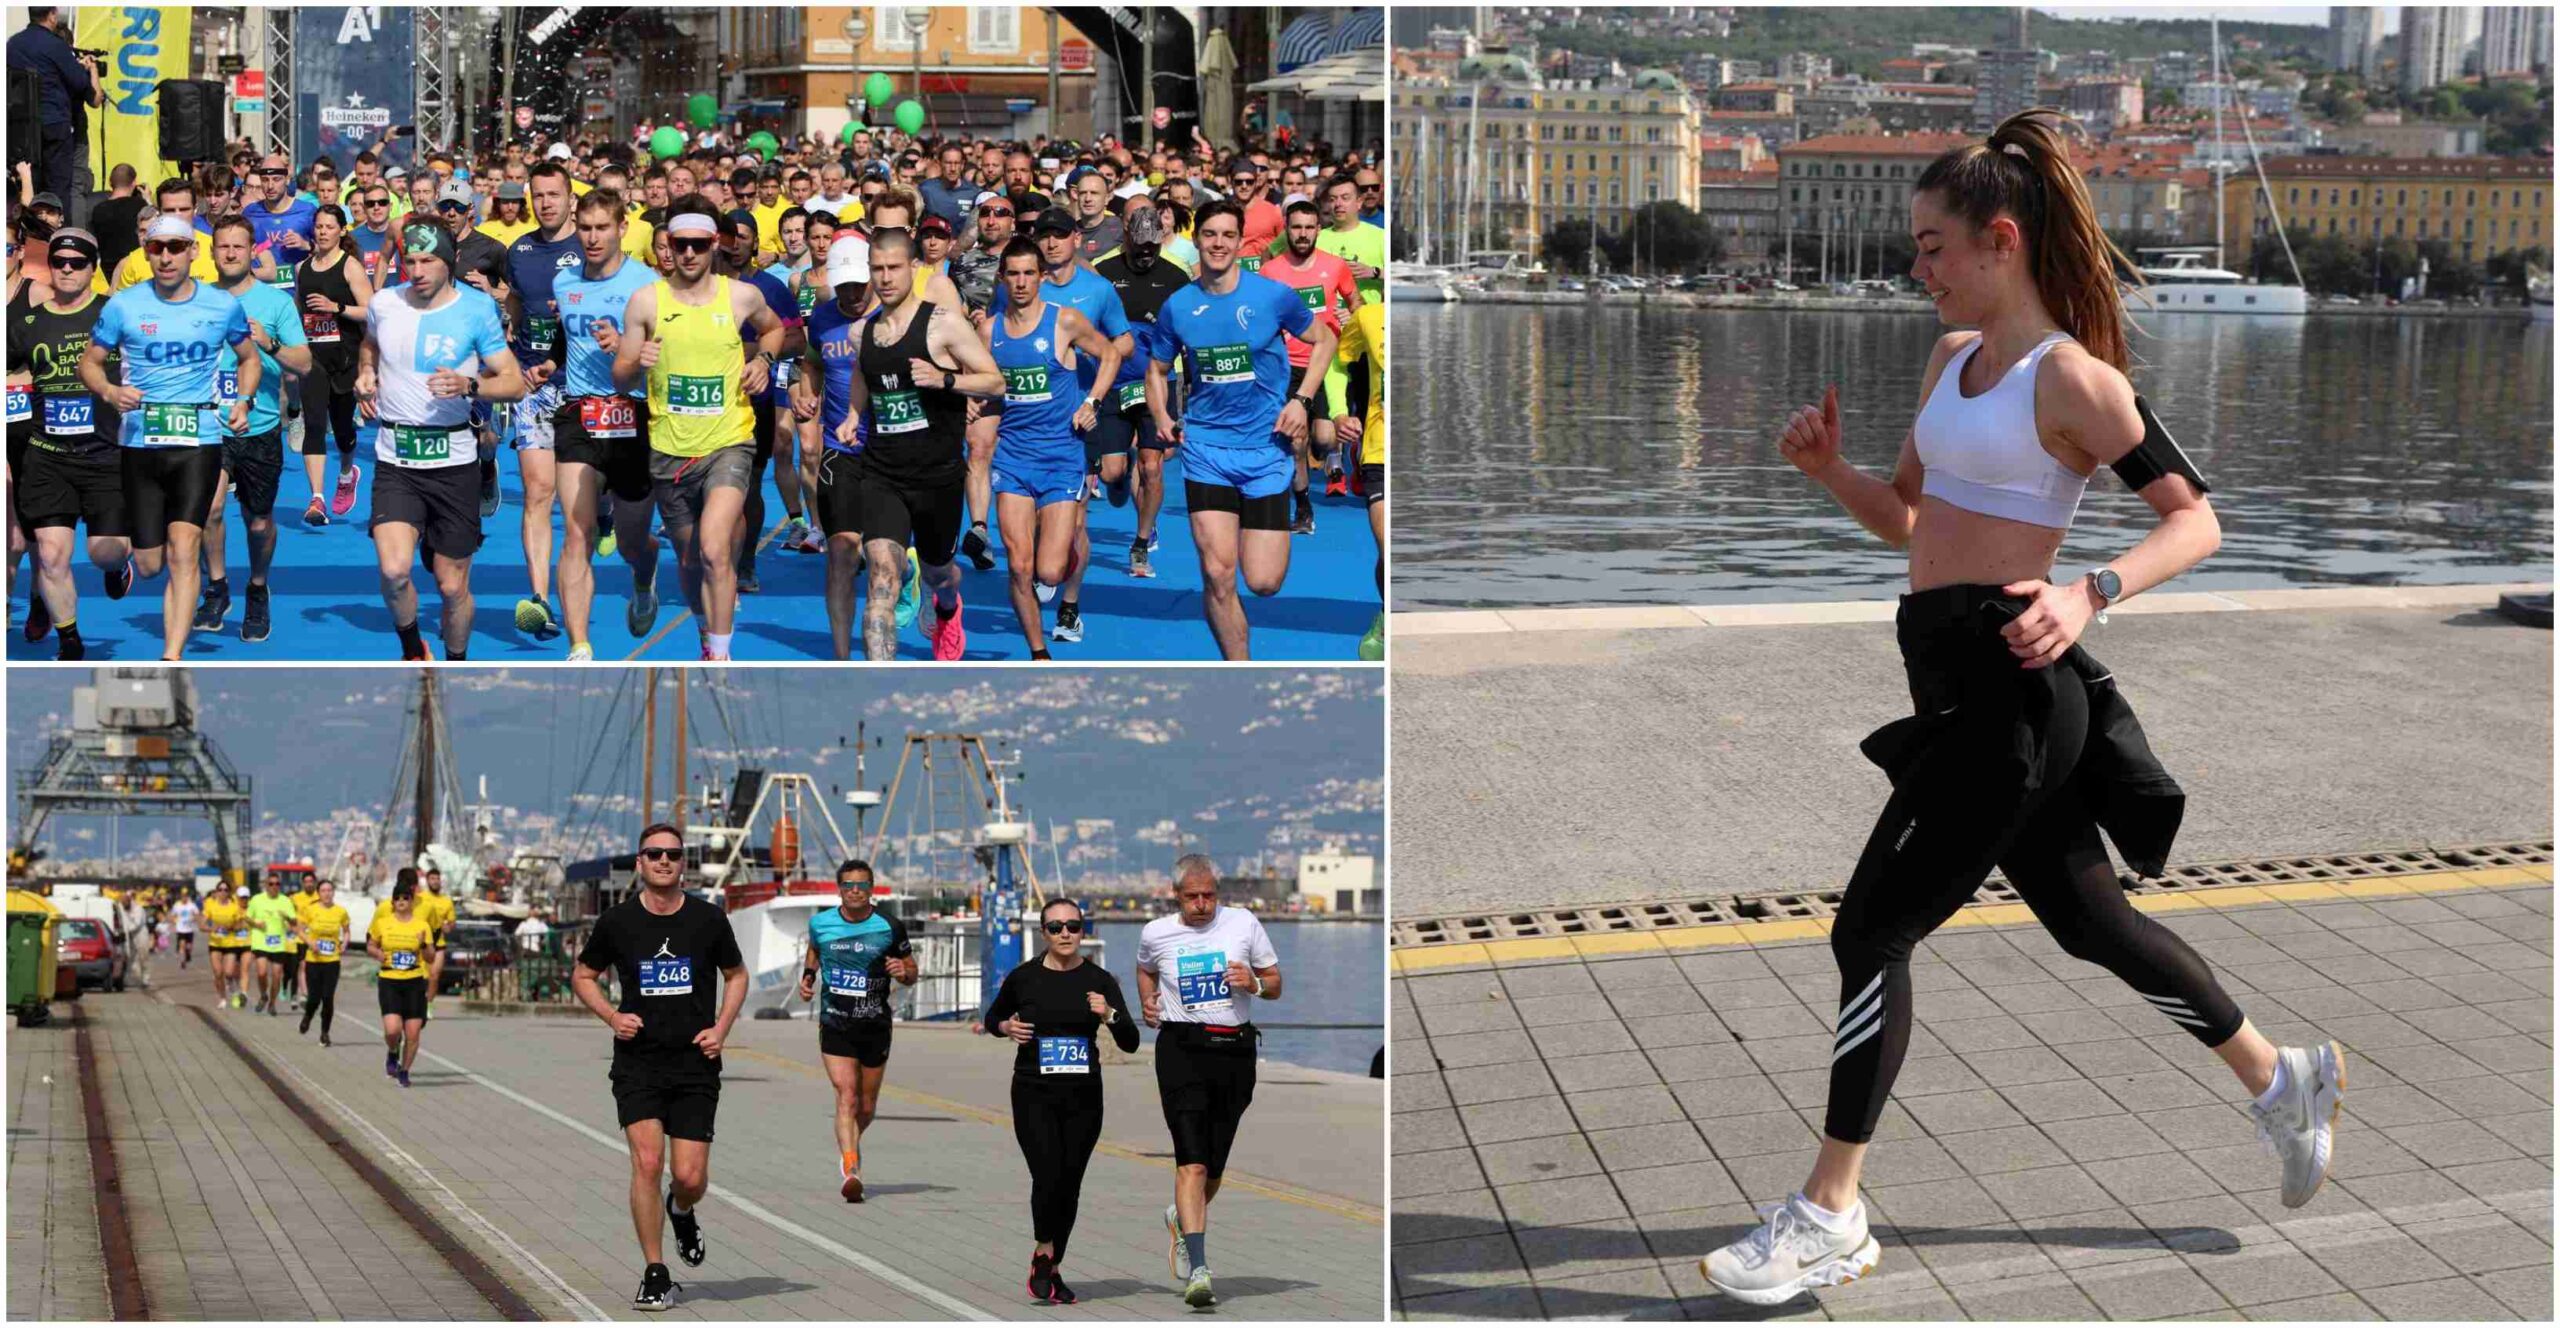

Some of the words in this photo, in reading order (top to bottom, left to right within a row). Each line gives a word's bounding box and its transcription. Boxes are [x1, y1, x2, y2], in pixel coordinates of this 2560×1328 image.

[337, 6, 381, 44] A1
[117, 7, 161, 115] RUN
[326, 111, 385, 122] Heineken
[1309, 293, 1317, 305] 4
[315, 321, 337, 333] 408
[144, 341, 208, 363] CRO
[1015, 373, 1046, 390] 219
[7, 393, 27, 410] 59
[687, 385, 722, 402] 316
[59, 406, 90, 422] 647
[600, 408, 633, 425] 608
[887, 399, 921, 419] 295
[165, 414, 197, 433] 105
[414, 437, 447, 455] 120
[658, 966, 689, 983] 648
[842, 974, 866, 987] 728
[1197, 979, 1228, 998] 716
[1058, 1045, 1087, 1061] 734
